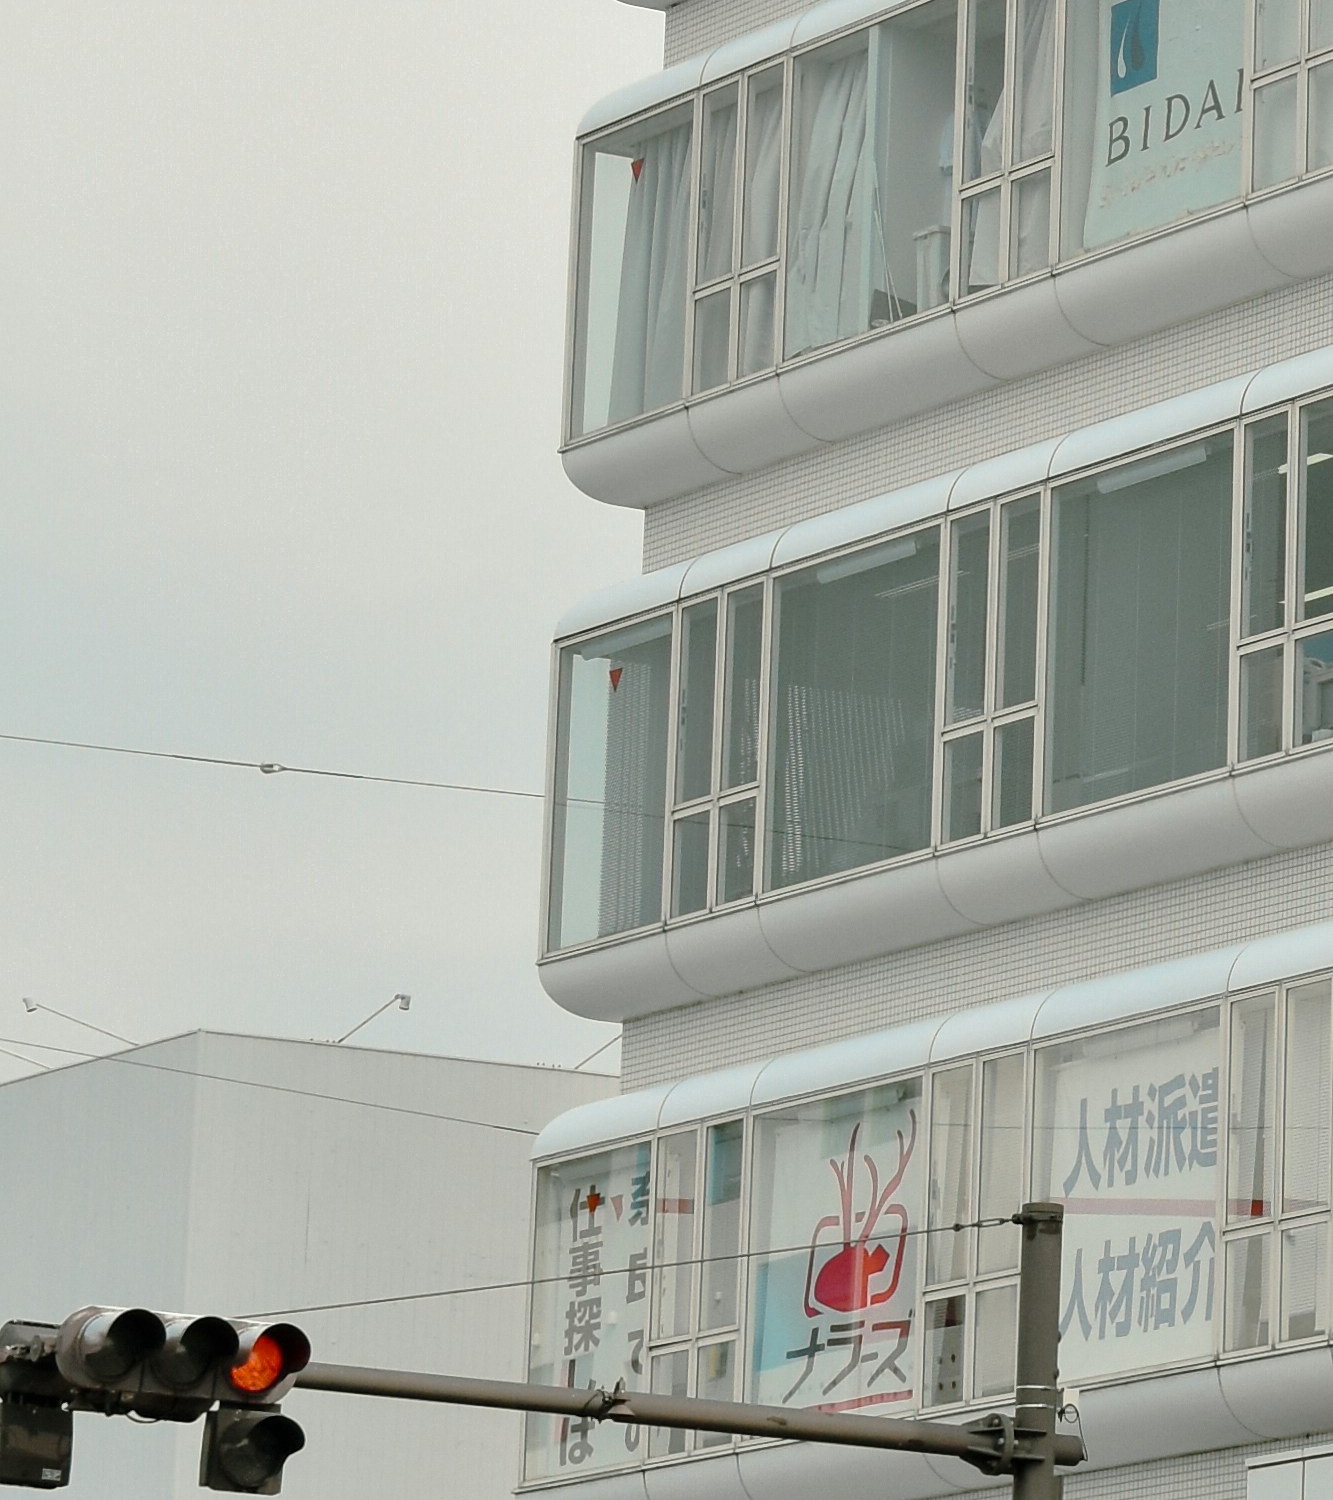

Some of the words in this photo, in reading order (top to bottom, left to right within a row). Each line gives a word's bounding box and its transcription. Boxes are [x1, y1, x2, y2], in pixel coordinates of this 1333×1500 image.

[1063, 1066, 1220, 1199] 人材派遣
[1059, 1220, 1216, 1341] 人材紹介
